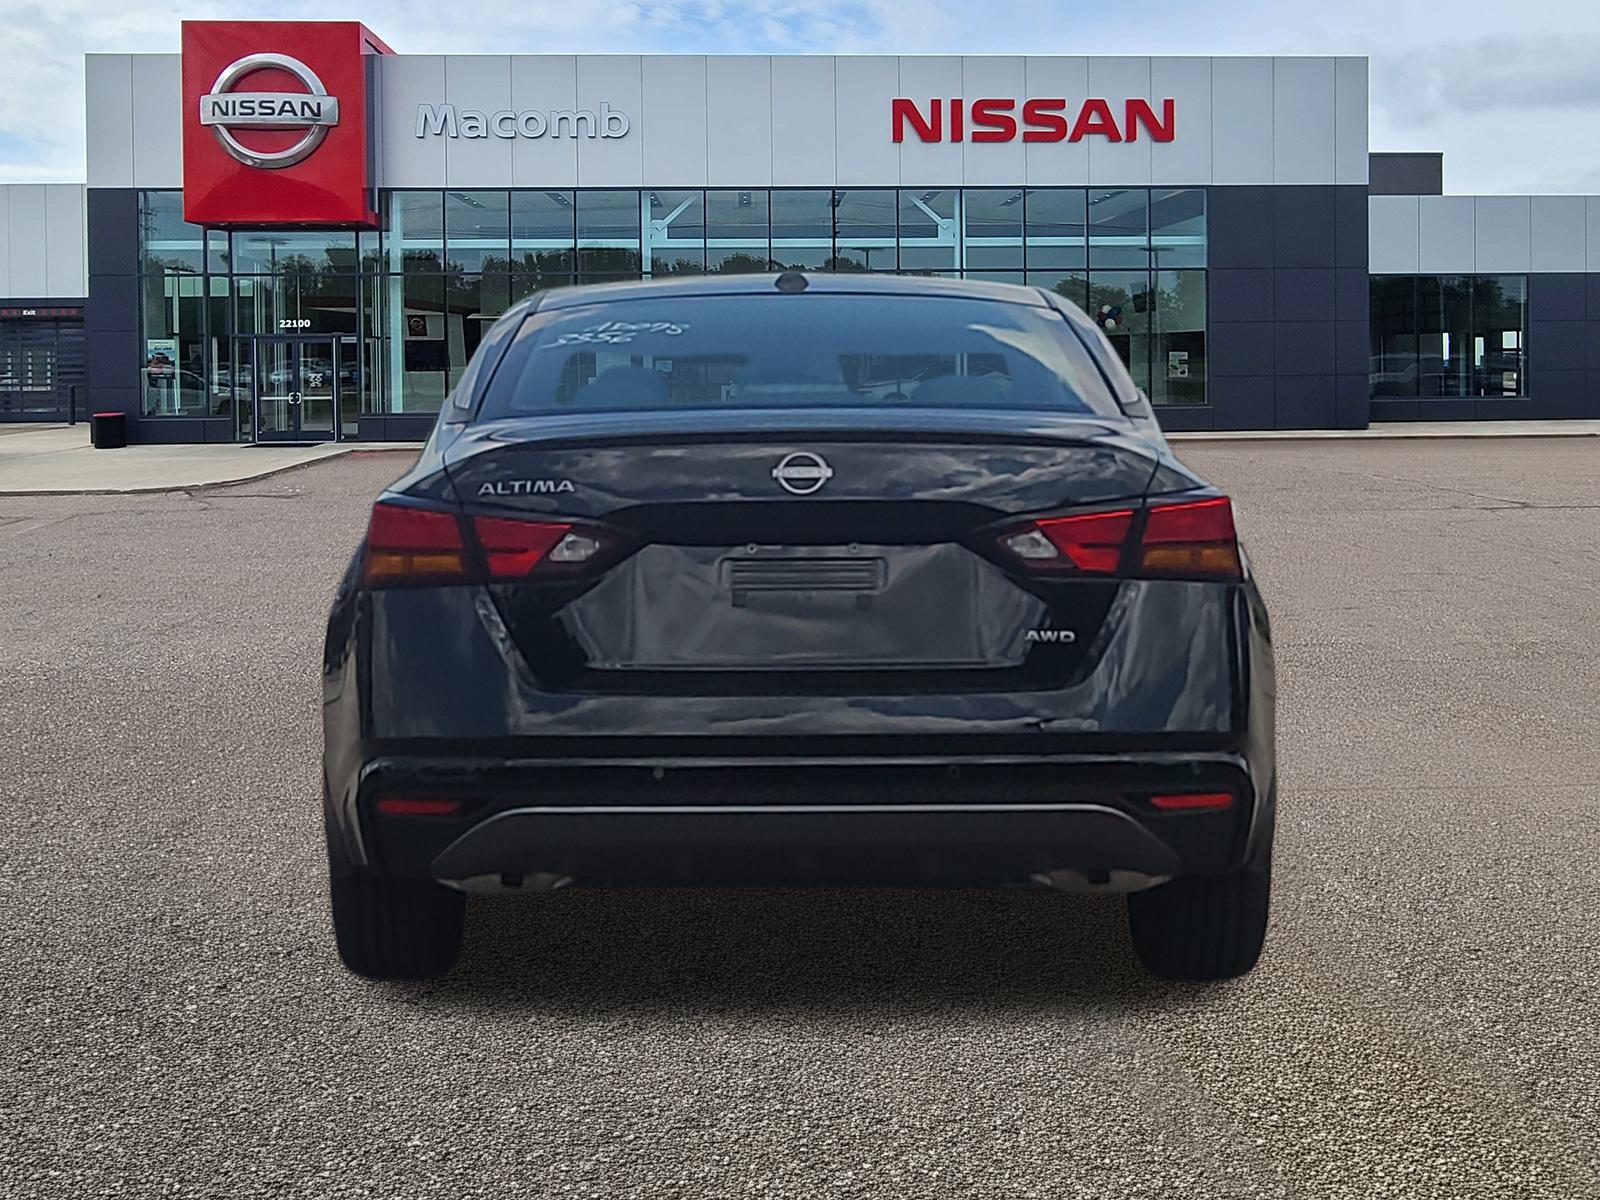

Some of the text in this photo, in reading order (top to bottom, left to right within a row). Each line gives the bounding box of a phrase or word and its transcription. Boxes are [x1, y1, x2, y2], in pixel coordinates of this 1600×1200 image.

[211, 100, 322, 117] NISSAN
[415, 101, 630, 138] Macomb
[892, 98, 1176, 142] NISSAN
[279, 319, 311, 328] 22100
[478, 480, 575, 495] ALTIMA
[1025, 630, 1076, 642] AWD
